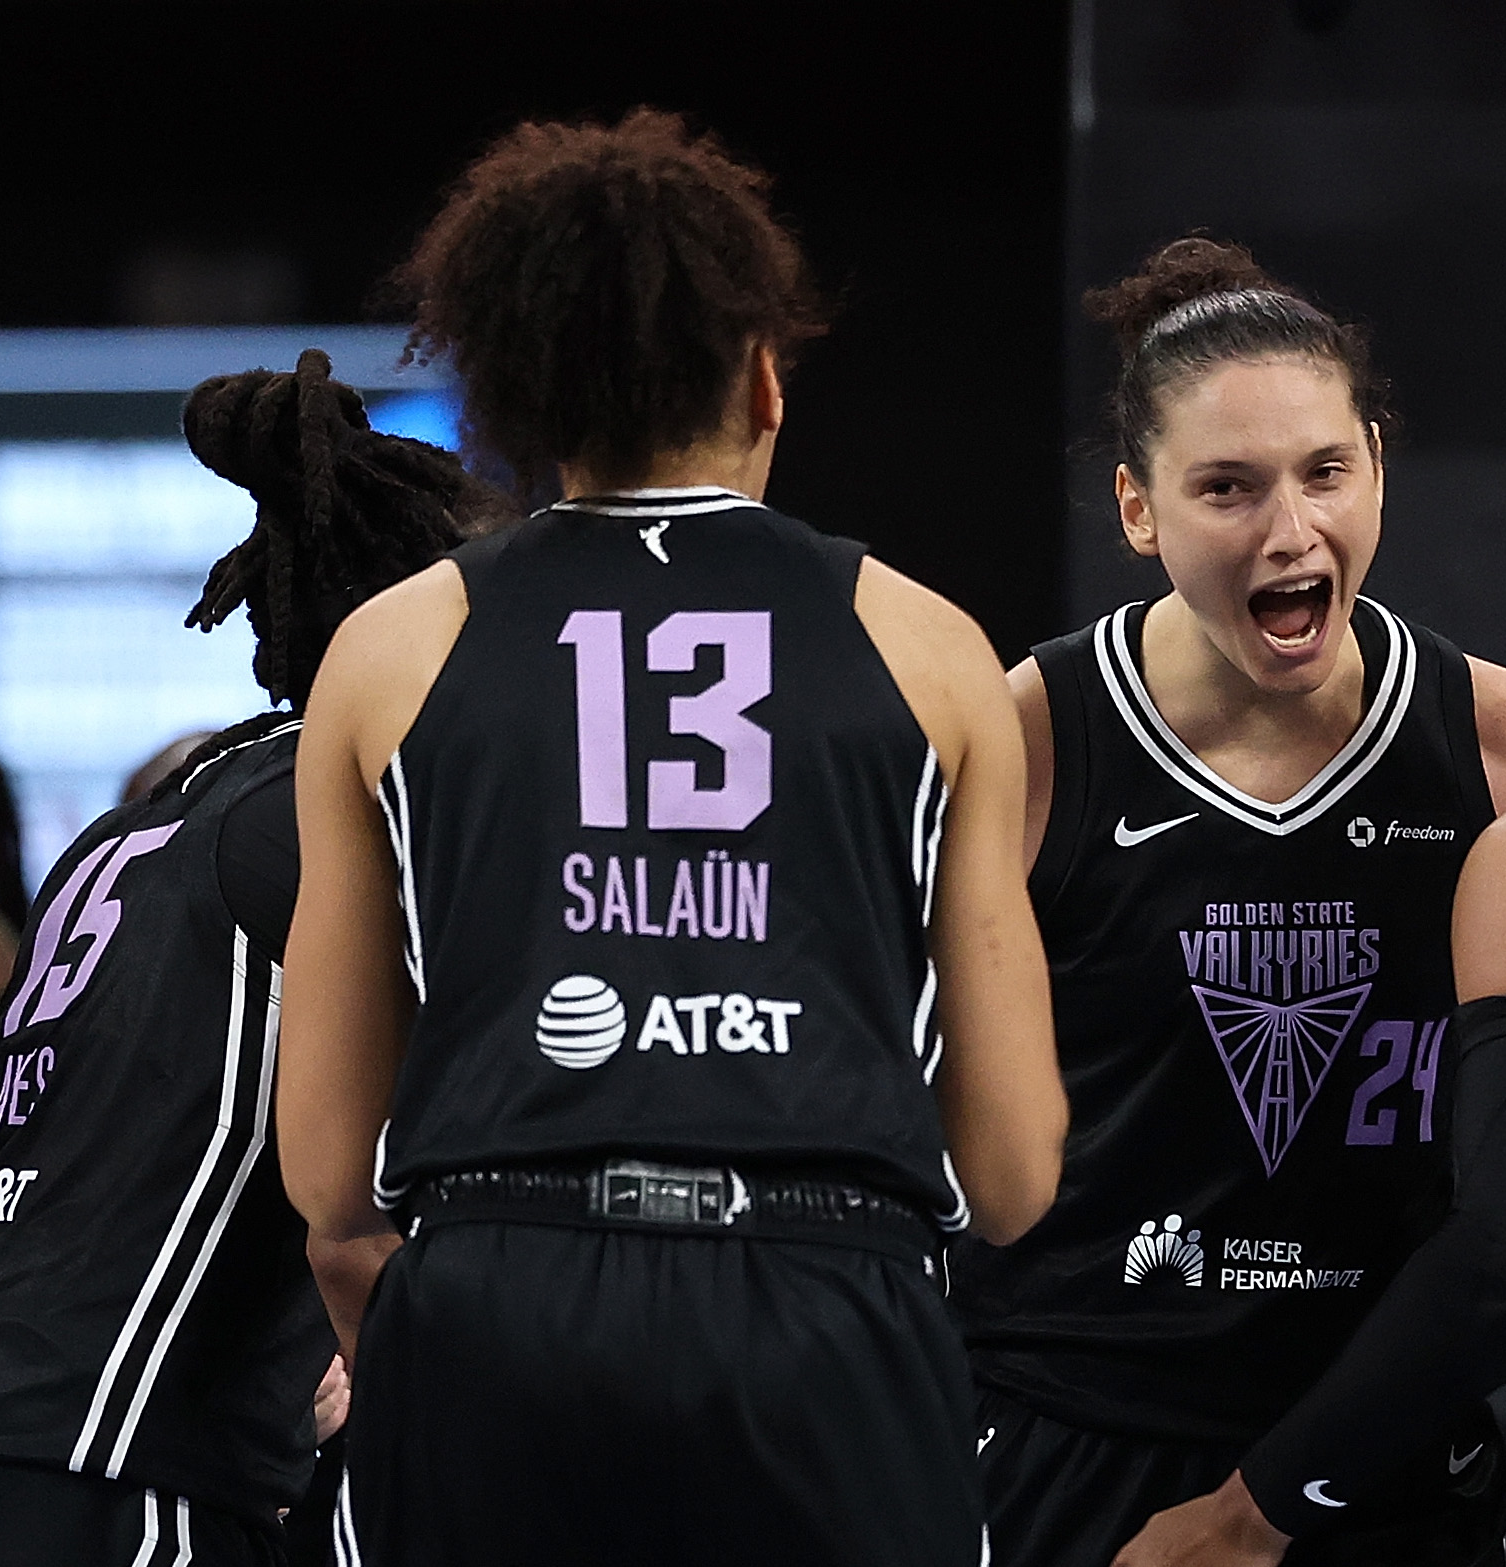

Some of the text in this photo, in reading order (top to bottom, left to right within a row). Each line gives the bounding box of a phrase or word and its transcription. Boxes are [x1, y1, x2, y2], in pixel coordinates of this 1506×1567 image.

[557, 610, 772, 831] 13
[1384, 819, 1455, 846] freedom
[2, 819, 186, 1038] 15
[562, 849, 770, 942] SALAÜN
[1205, 901, 1356, 926] GOLDEN STATE
[1179, 928, 1380, 1000] VALKYRIES
[636, 993, 802, 1055] AT&T
[1345, 1016, 1450, 1146] 24
[1220, 1267, 1364, 1290] PERMANENTE
[1223, 1237, 1302, 1265] KAISER
